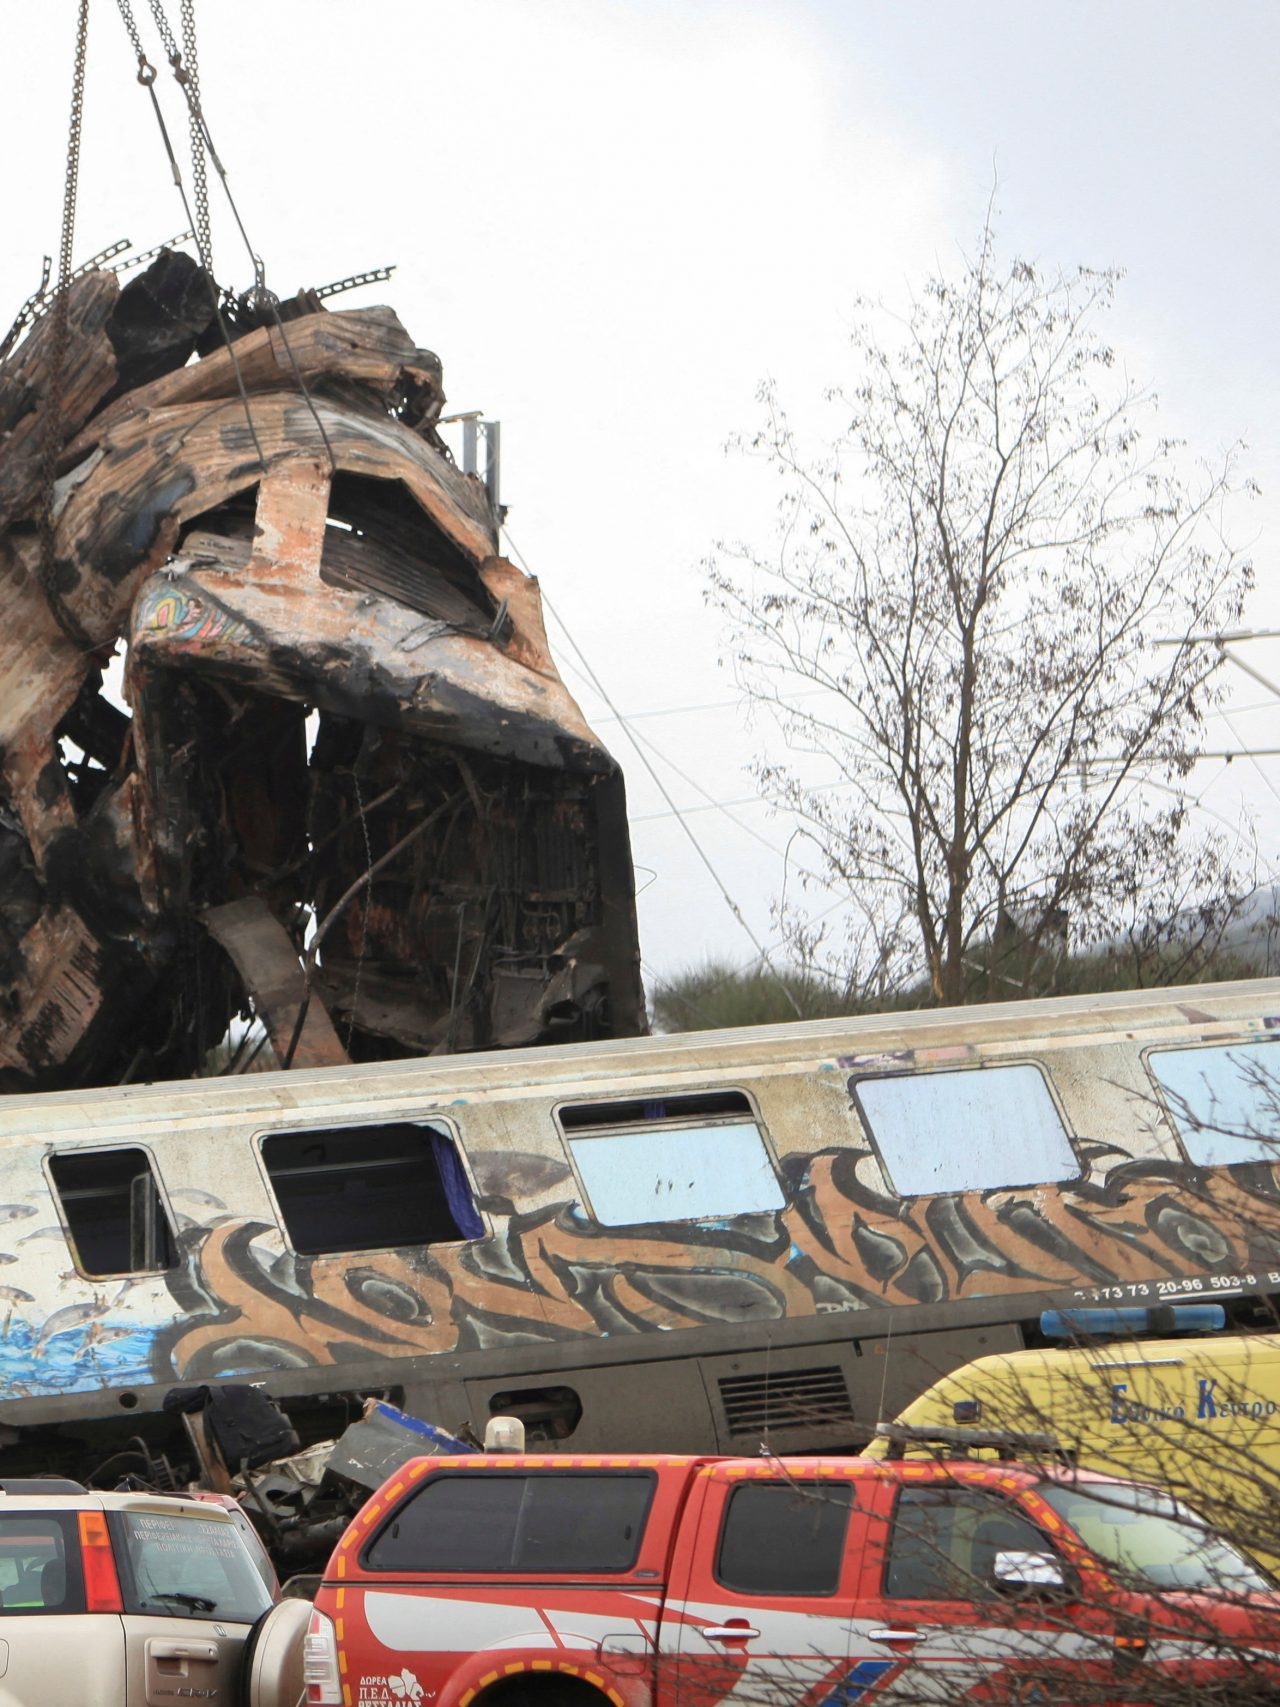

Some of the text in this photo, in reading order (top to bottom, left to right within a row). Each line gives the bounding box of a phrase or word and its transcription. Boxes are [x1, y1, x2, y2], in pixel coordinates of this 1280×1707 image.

[1101, 1286, 1124, 1299] 73
[1126, 1284, 1150, 1297] 73
[1156, 1278, 1203, 1294] 20-96
[1210, 1274, 1257, 1289] 503-8
[360, 1676, 387, 1685] ΔΩΡΕΑ
[359, 1687, 392, 1700] Π.Ε.Δ.
